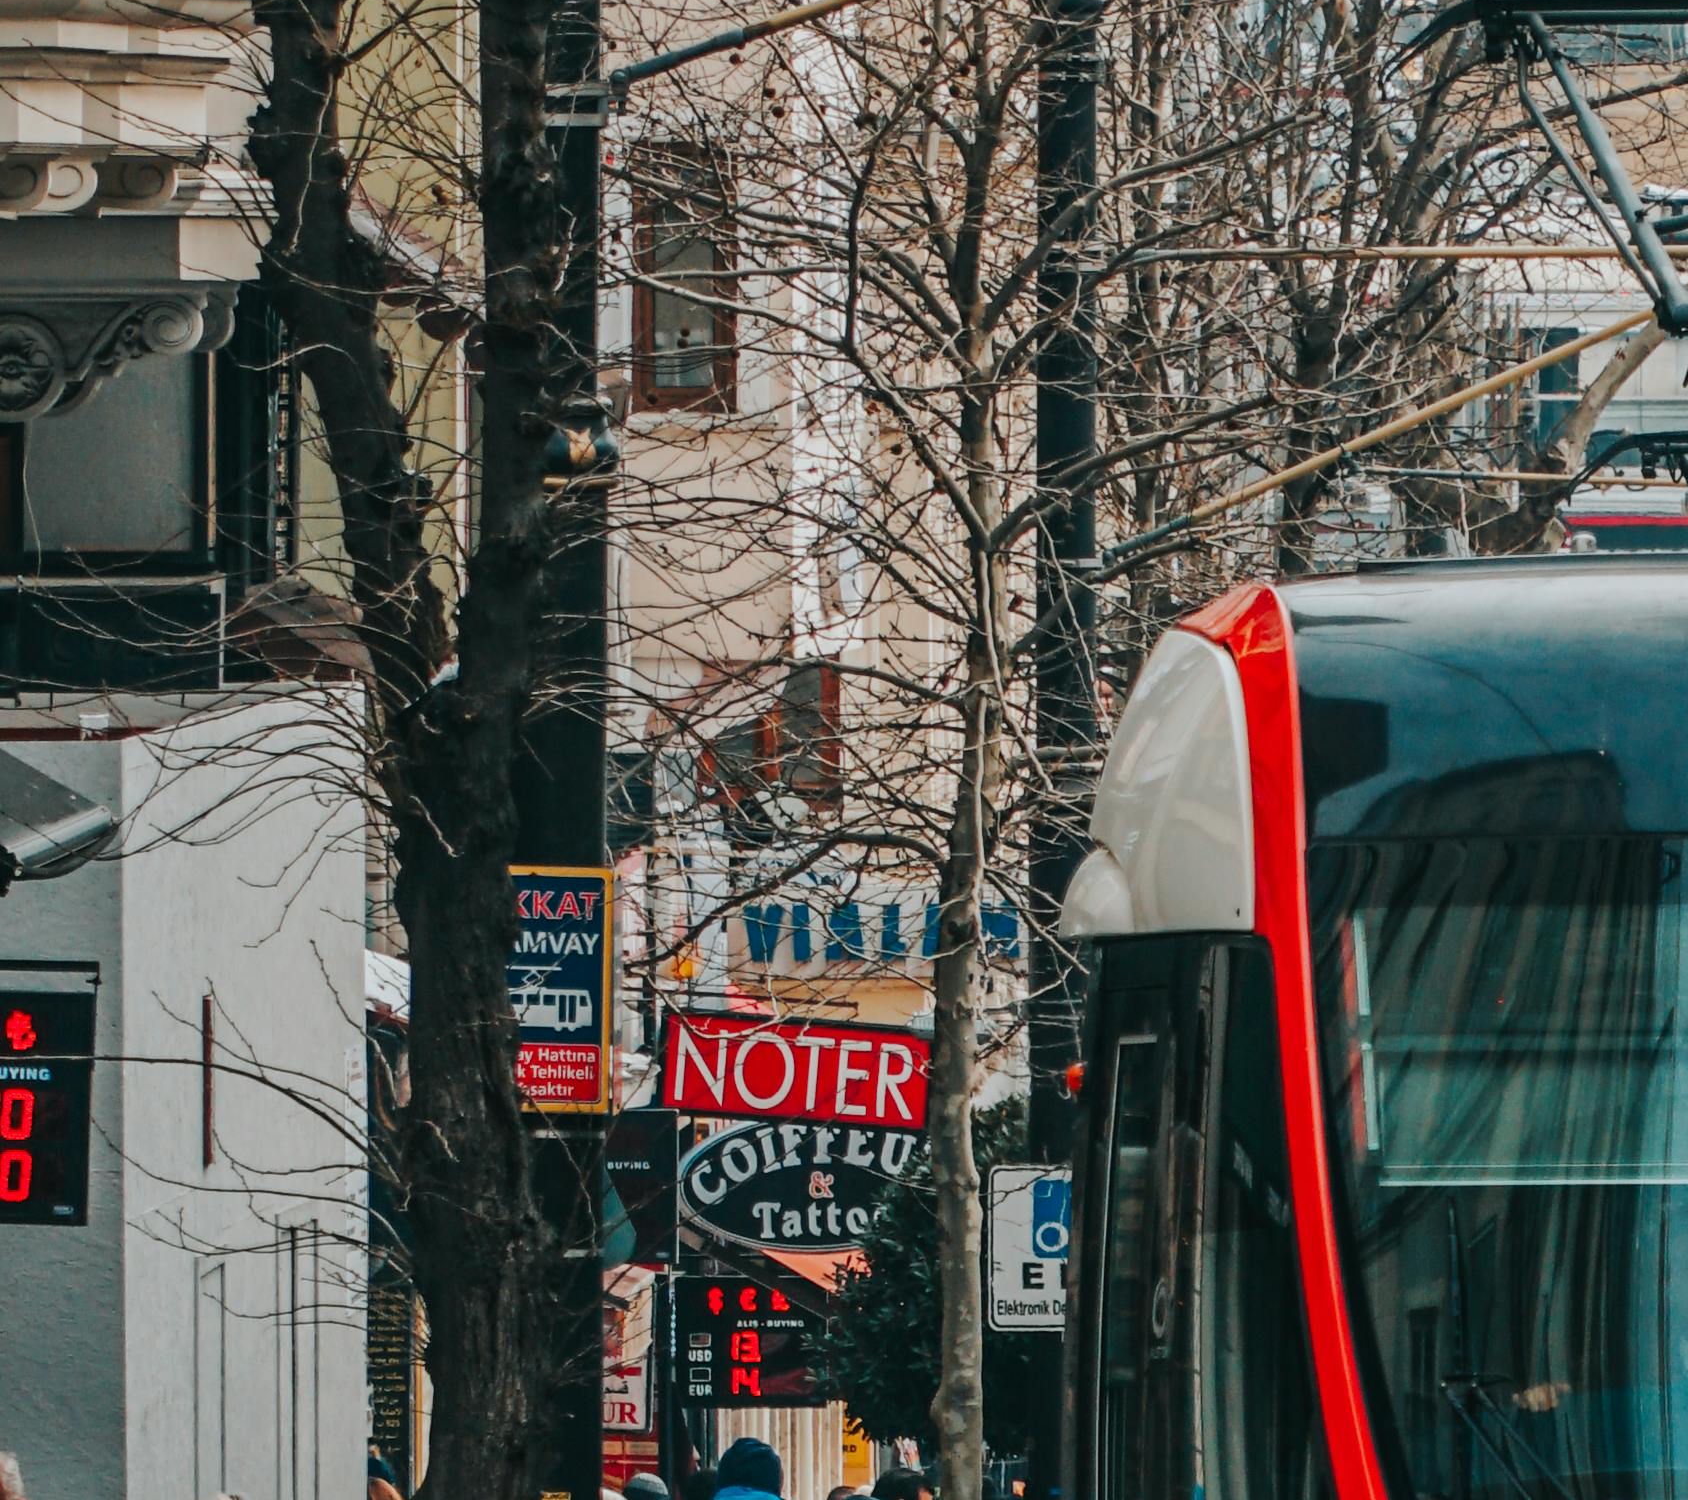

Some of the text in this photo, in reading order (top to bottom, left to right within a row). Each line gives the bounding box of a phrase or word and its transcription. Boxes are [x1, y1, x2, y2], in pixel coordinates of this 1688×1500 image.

[538, 1048, 596, 1063] Hattına
[0, 1067, 51, 1080] UYING
[531, 1065, 594, 1081] Tehlikeli
[673, 1026, 914, 1121] NOTER
[691, 1124, 919, 1206] COIFFEU
[808, 1171, 834, 1199] &
[997, 1300, 1050, 1315] Elektronik
[689, 1350, 712, 1363] USD
[689, 1384, 712, 1397] EUR
